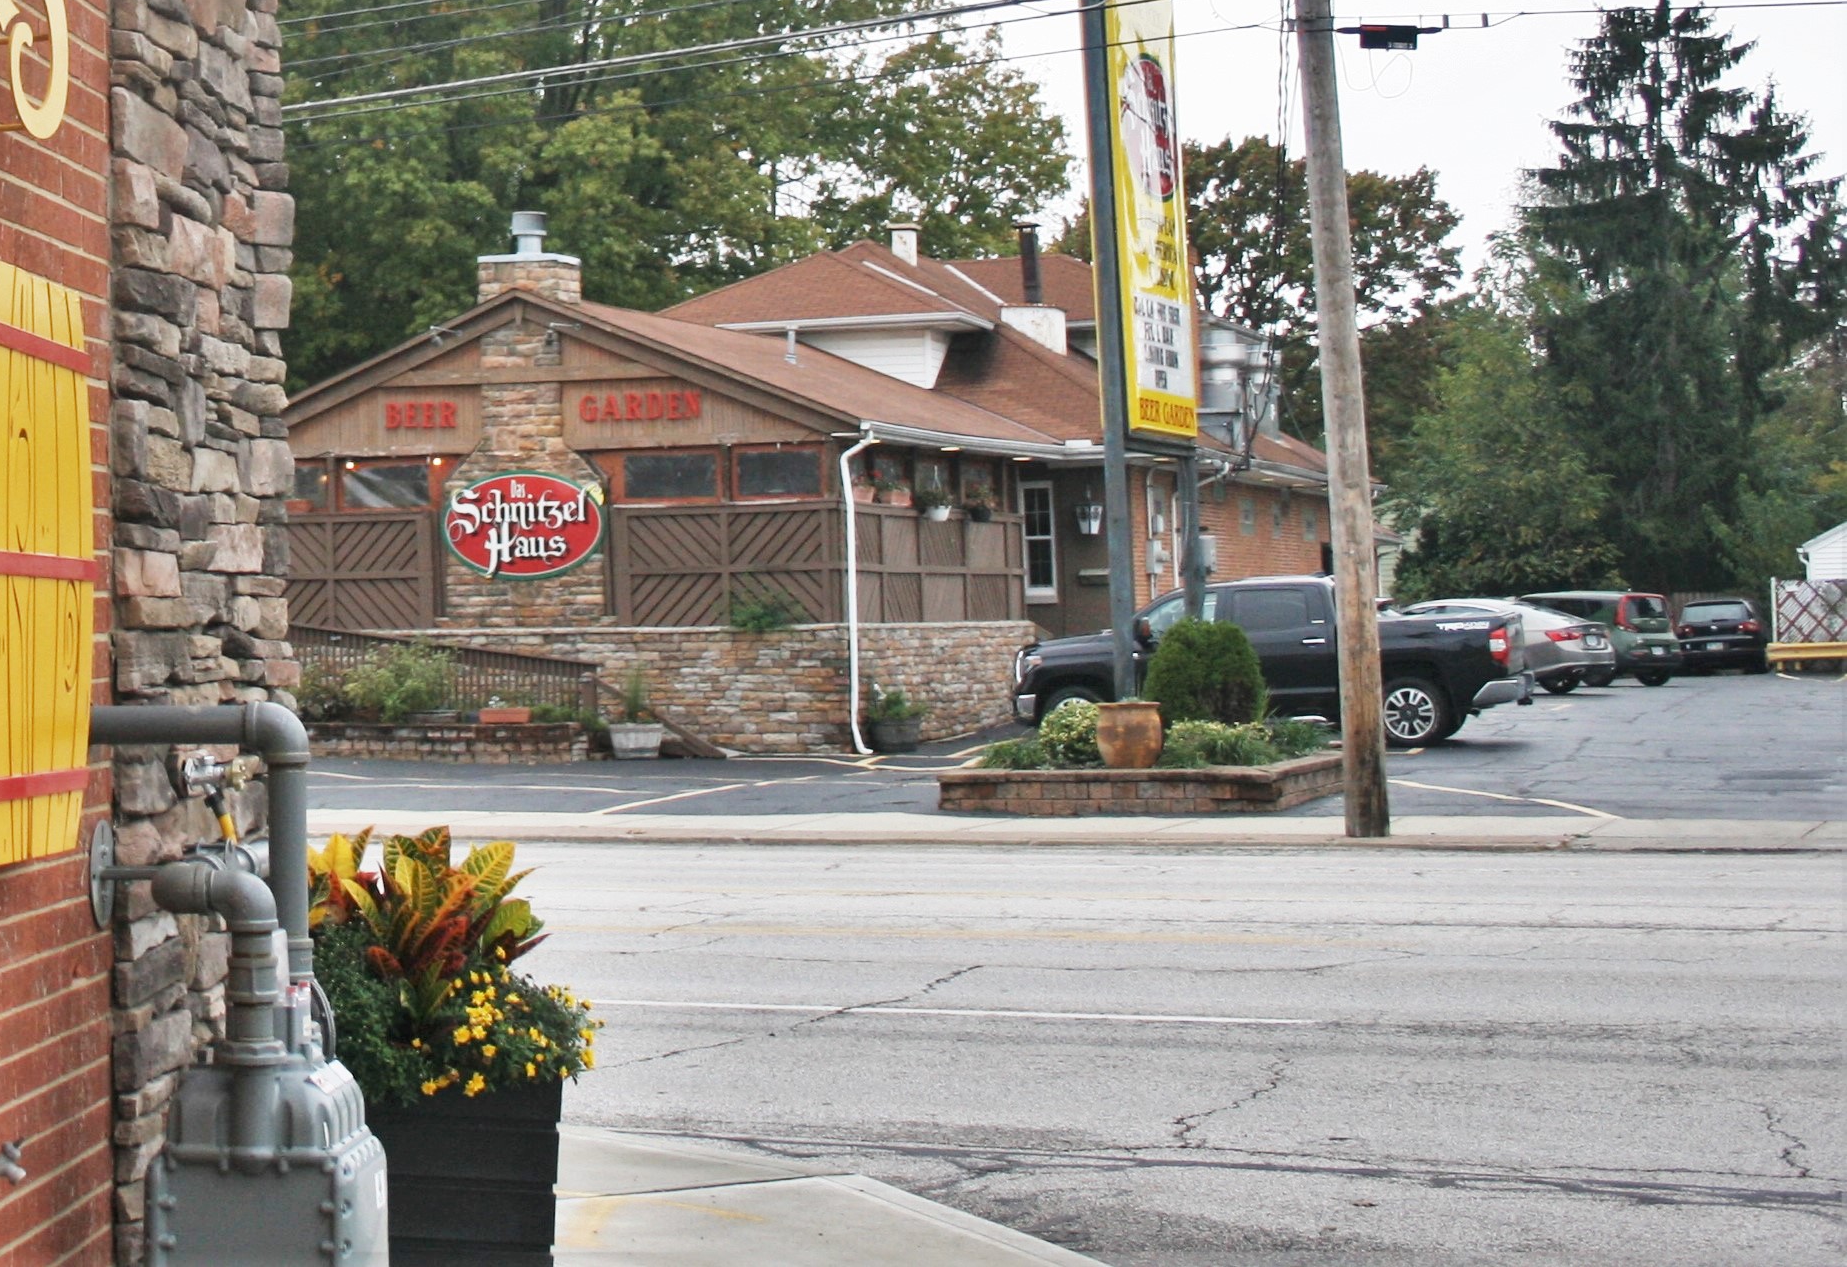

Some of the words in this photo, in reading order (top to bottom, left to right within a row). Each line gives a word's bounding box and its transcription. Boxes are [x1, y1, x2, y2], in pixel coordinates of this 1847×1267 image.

[385, 400, 458, 429] BEER
[578, 390, 701, 422] GARDEN
[1139, 397, 1161, 423] BEER
[1163, 402, 1194, 429] GARDEN
[510, 479, 526, 499] Das
[448, 486, 586, 541] Schnitzel
[484, 521, 567, 578] Haus
